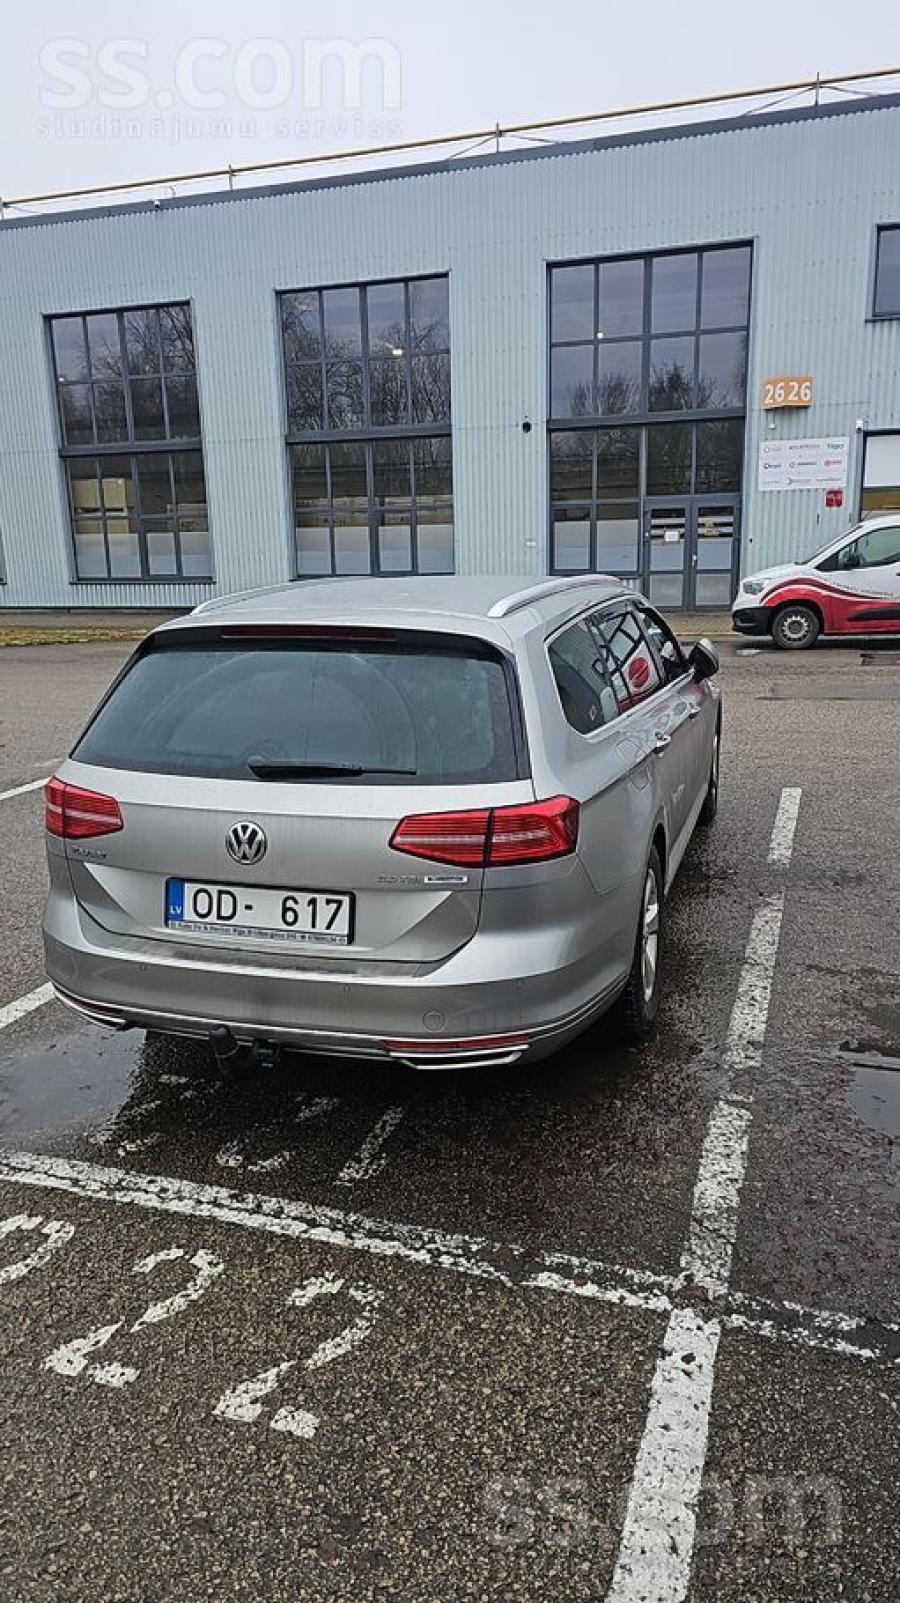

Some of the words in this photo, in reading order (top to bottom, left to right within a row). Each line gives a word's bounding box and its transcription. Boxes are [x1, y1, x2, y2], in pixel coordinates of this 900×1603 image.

[764, 383, 785, 404] 26
[788, 381, 811, 402] 26
[170, 905, 182, 914] LV
[281, 895, 343, 931] 617
